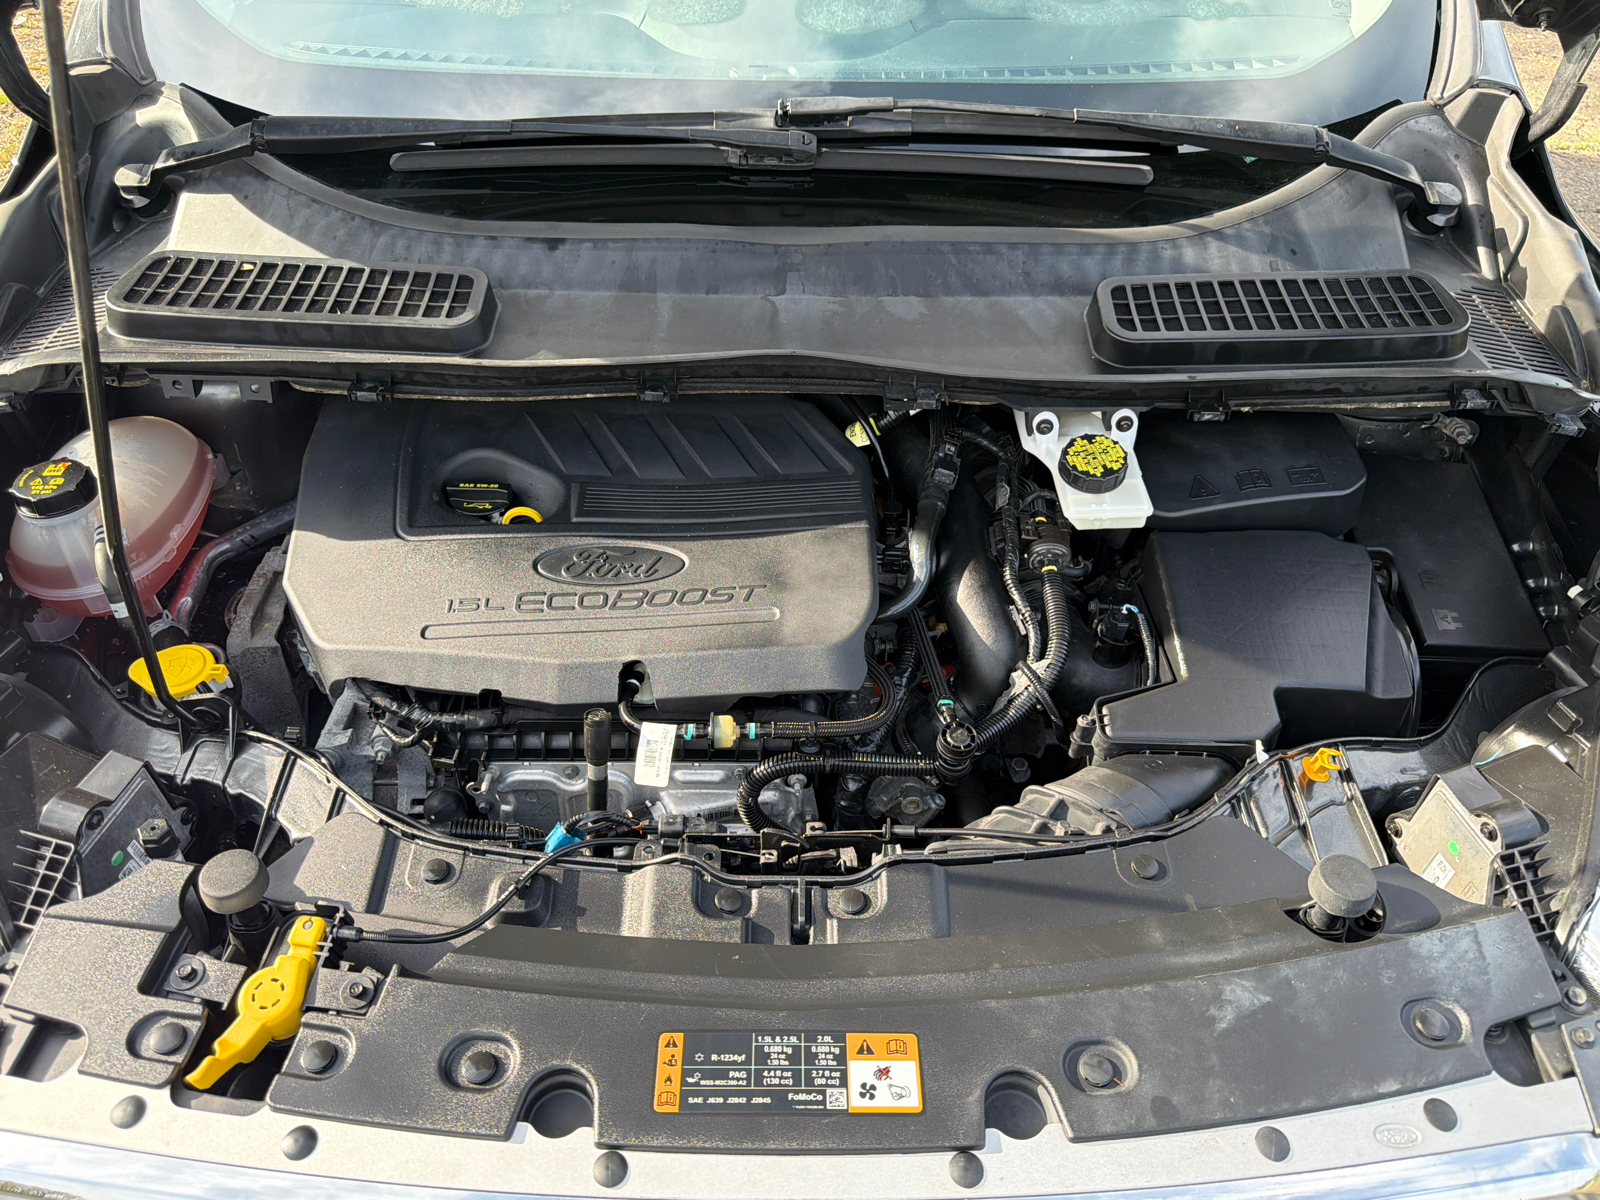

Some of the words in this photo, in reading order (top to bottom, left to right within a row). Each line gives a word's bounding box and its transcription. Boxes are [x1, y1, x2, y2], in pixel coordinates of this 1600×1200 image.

[560, 549, 665, 579] Ford
[444, 596, 506, 615] 1.5L
[514, 584, 767, 614] ECOBOOST
[816, 1035, 834, 1043] 2.0L
[783, 1046, 792, 1054] kg
[830, 1046, 840, 1054] kg
[711, 1053, 746, 1063] R-1234yf
[728, 1071, 748, 1079] PAG
[811, 1070, 824, 1078] 2.7
[823, 1070, 831, 1078] fl
[763, 1078, 780, 1086] (130
[780, 1078, 793, 1086] cc)
[814, 1078, 827, 1086] (80
[827, 1078, 840, 1086] cc)
[687, 1096, 704, 1104] SAE
[705, 1096, 724, 1104] J639
[725, 1096, 747, 1104] J2842
[750, 1096, 772, 1104] J2845
[788, 1093, 823, 1101] FoMoCo
